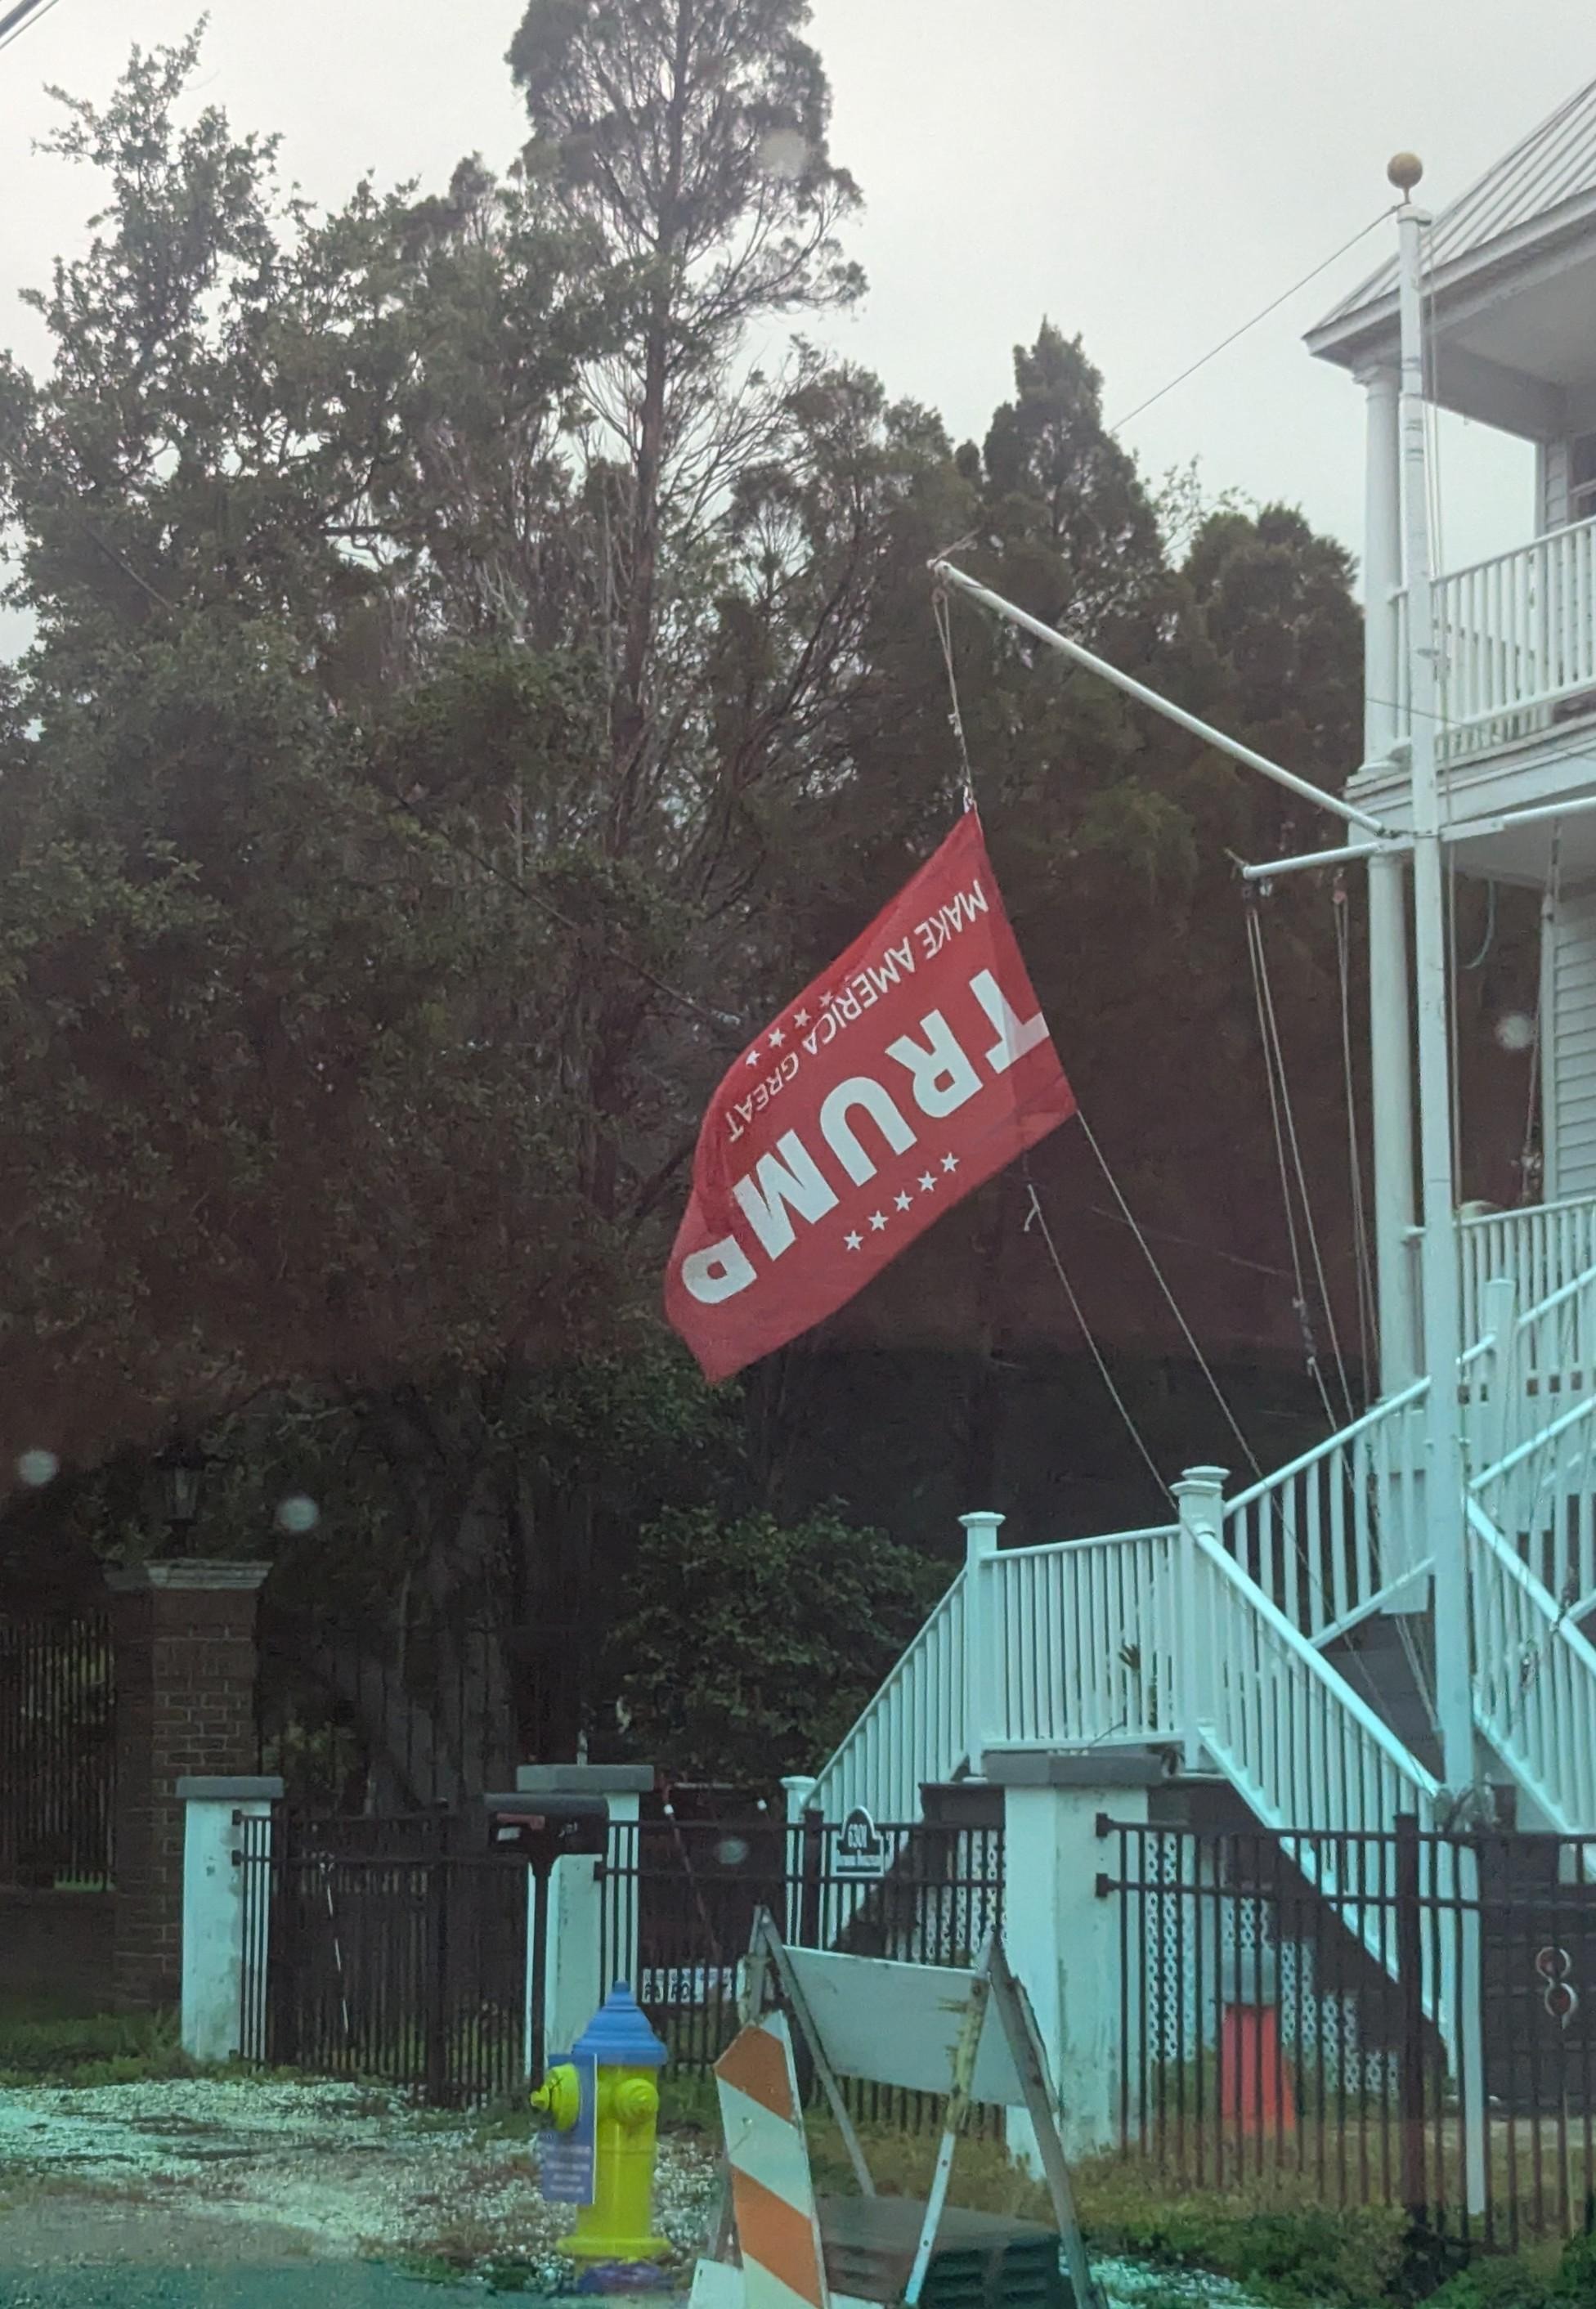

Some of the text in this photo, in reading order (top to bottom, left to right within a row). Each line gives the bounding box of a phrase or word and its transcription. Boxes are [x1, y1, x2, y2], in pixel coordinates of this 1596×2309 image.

[682, 969, 1050, 1303] TRUMP
[724, 880, 989, 1142] MAKE AMERICA GREAT
